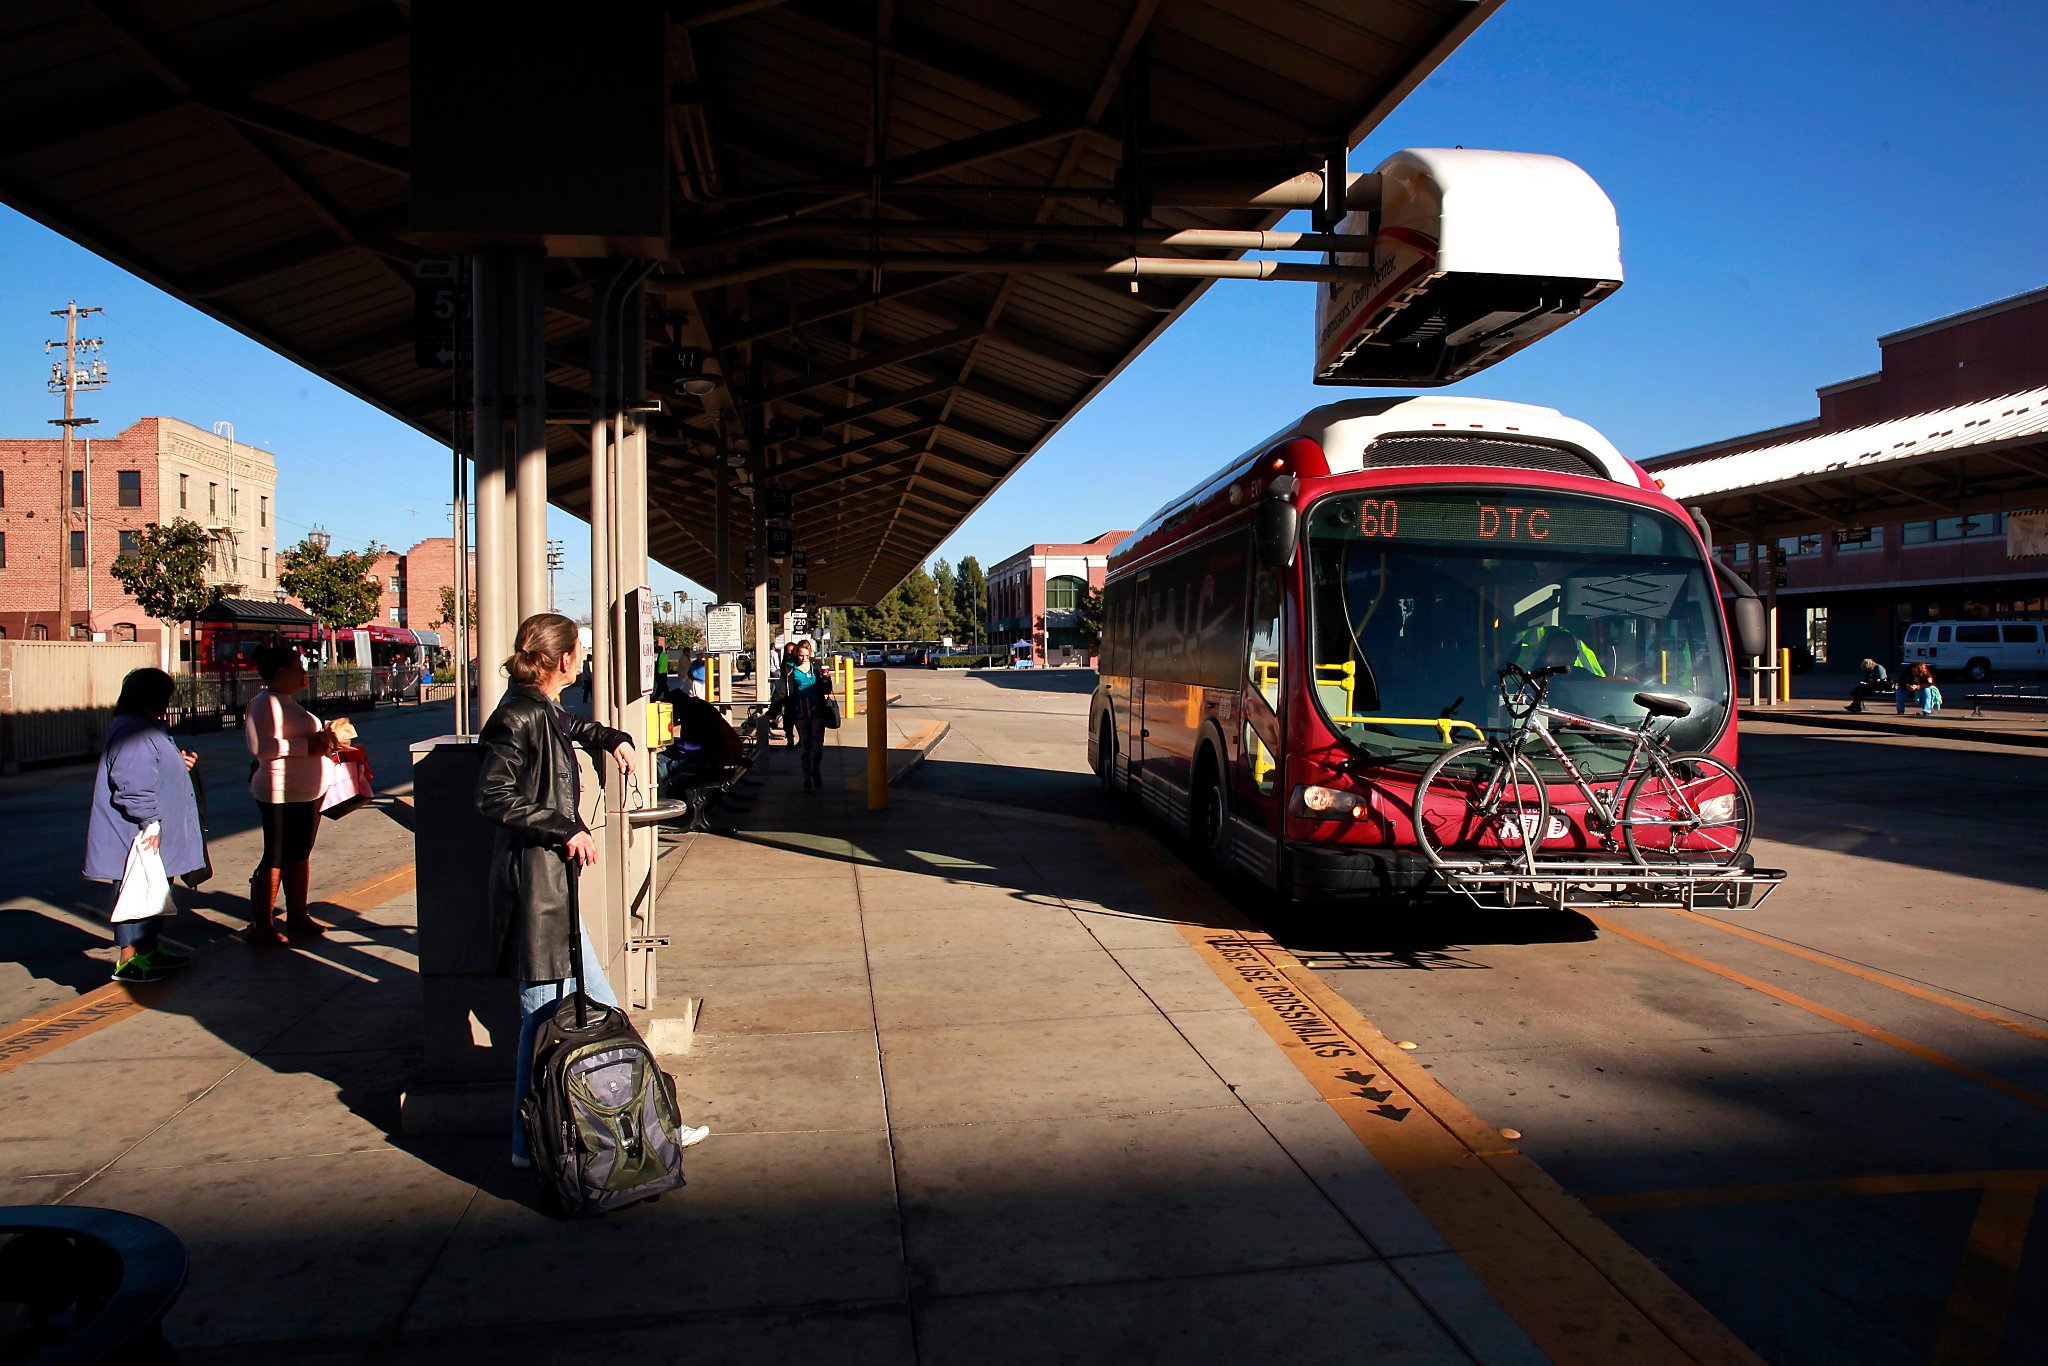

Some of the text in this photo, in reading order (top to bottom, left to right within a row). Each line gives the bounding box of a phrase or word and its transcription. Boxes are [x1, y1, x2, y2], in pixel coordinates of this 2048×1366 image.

[1361, 498, 1550, 538] 60 DTC
[1235, 965, 1280, 983] USE
[0, 1002, 133, 1060] SSWALKS
[1254, 985, 1357, 1058] CROSSWALKS
